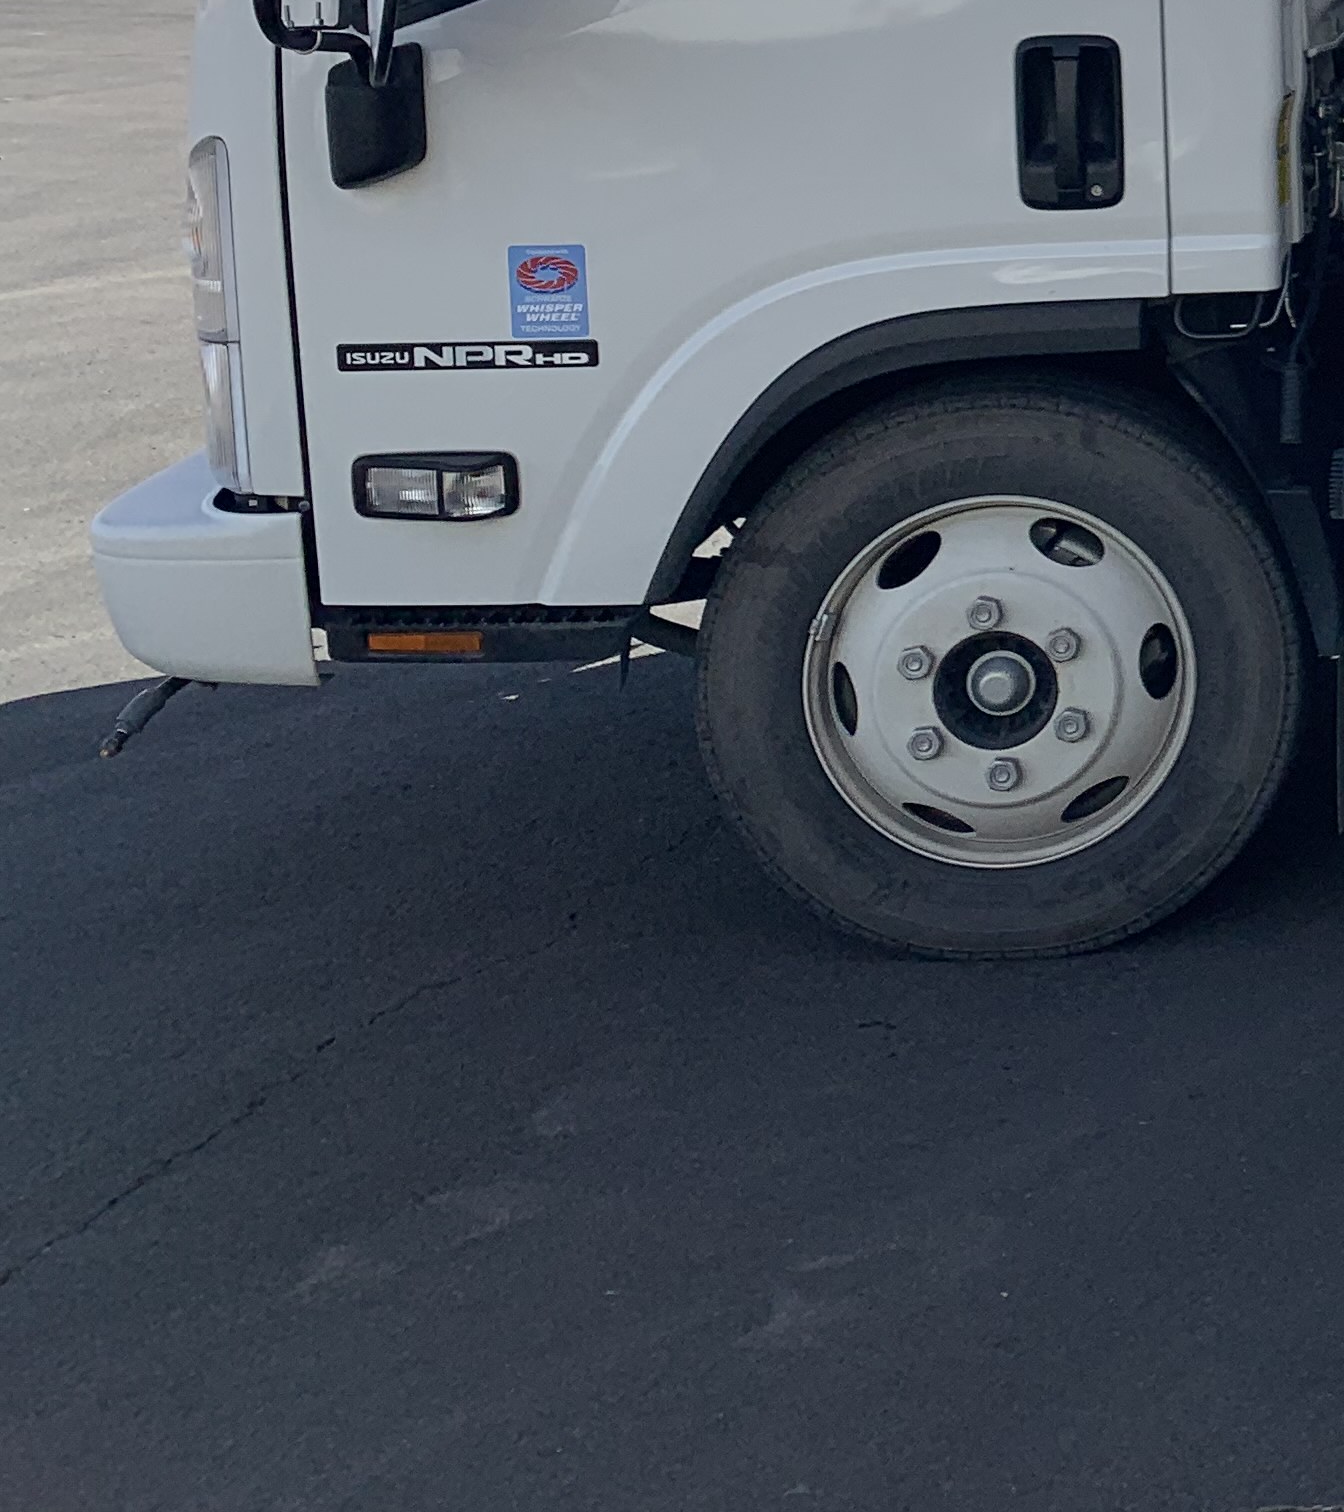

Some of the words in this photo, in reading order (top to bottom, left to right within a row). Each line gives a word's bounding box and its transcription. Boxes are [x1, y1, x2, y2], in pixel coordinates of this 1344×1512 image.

[516, 303, 583, 313] WHISPER
[525, 312, 579, 322] WHEEL
[520, 324, 581, 333] TECHNOLOGY
[346, 352, 409, 365] ISUZU
